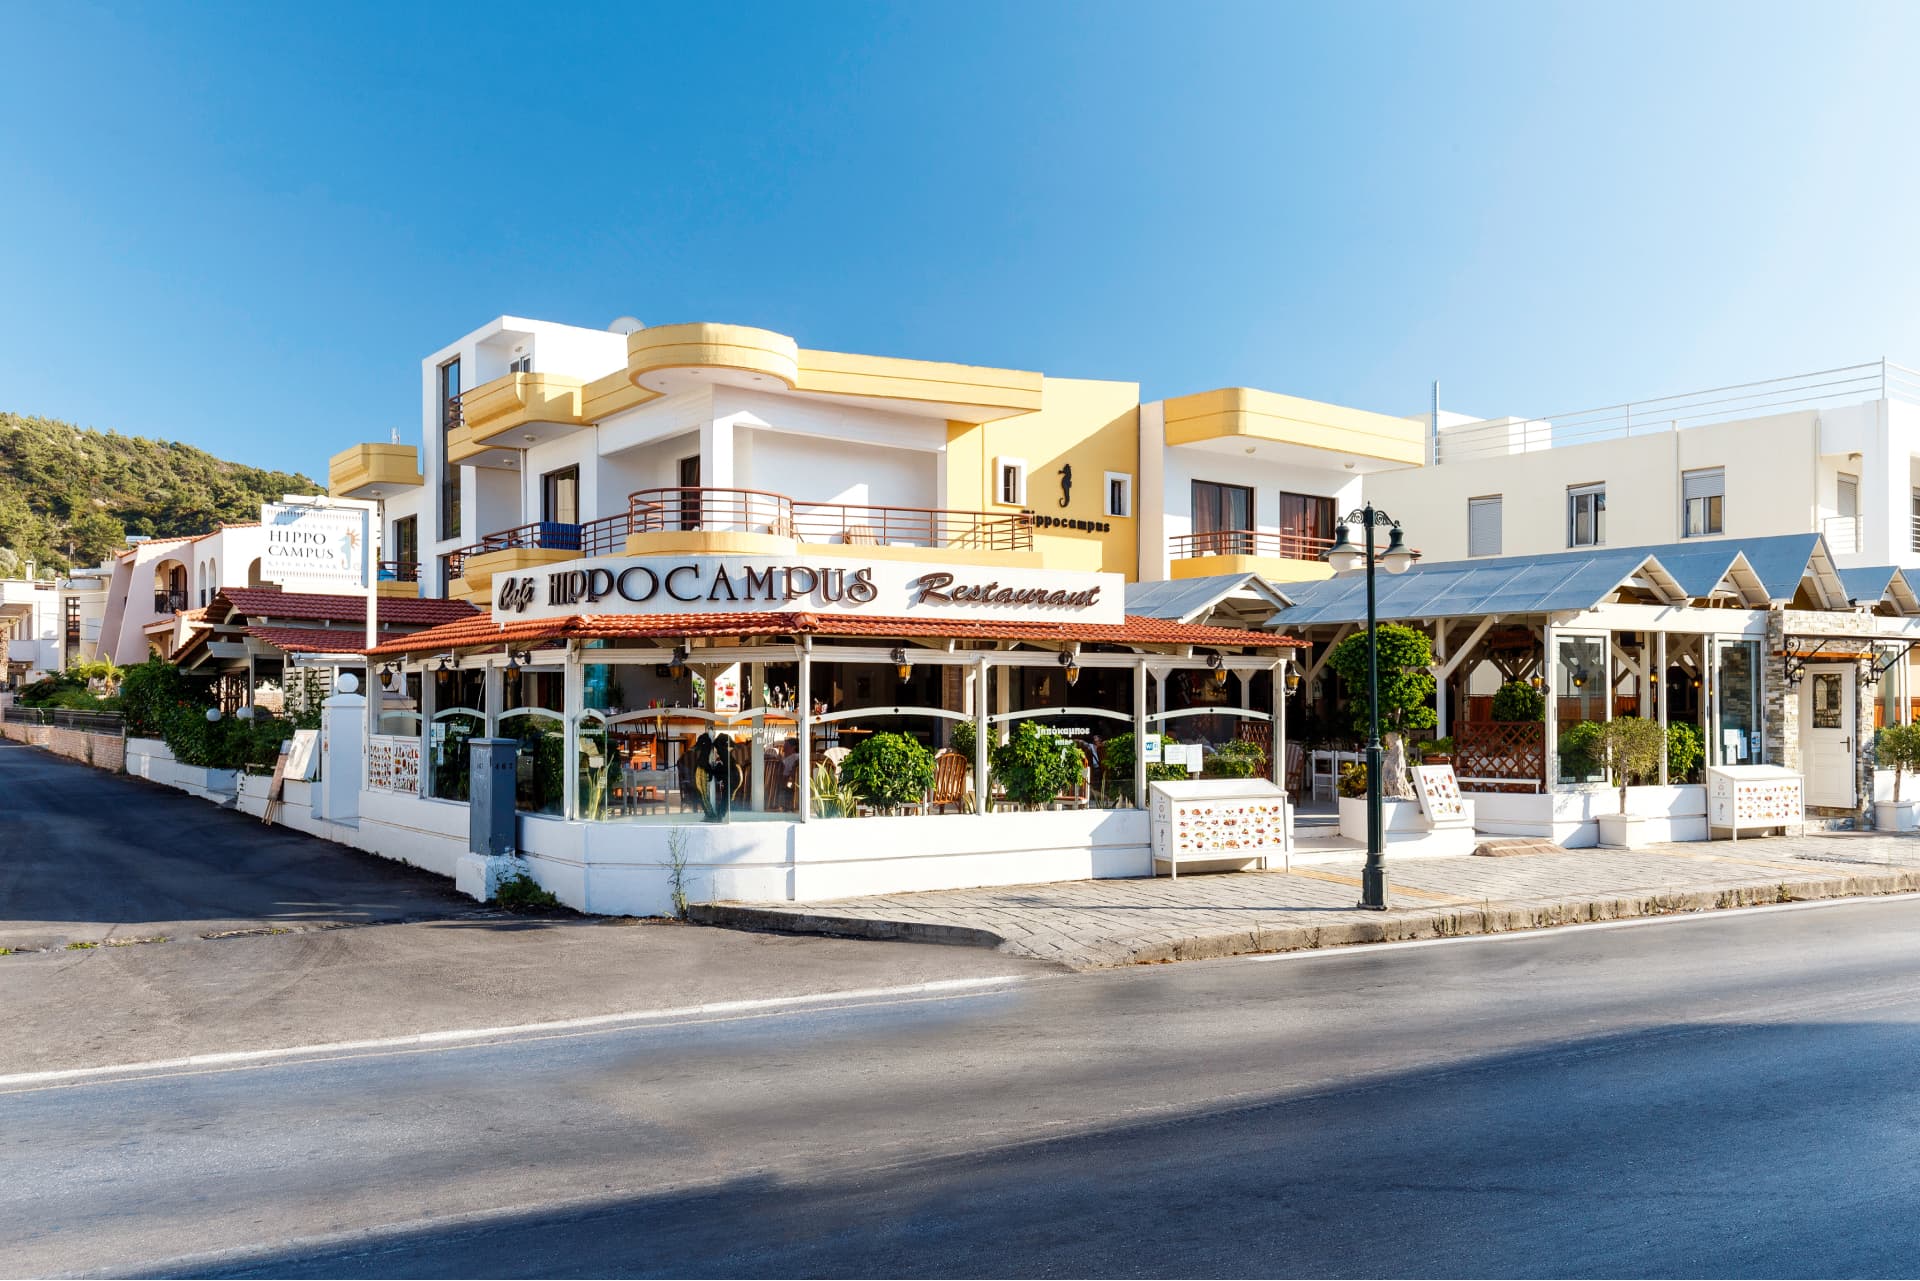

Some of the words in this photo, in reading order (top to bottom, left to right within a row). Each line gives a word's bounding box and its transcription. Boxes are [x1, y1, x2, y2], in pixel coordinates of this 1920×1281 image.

[270, 530, 326, 545] HIPPO
[268, 545, 334, 560] CAMPUS
[548, 562, 879, 607] HIPPOCAMPUS
[918, 572, 1101, 608] Restaurant
